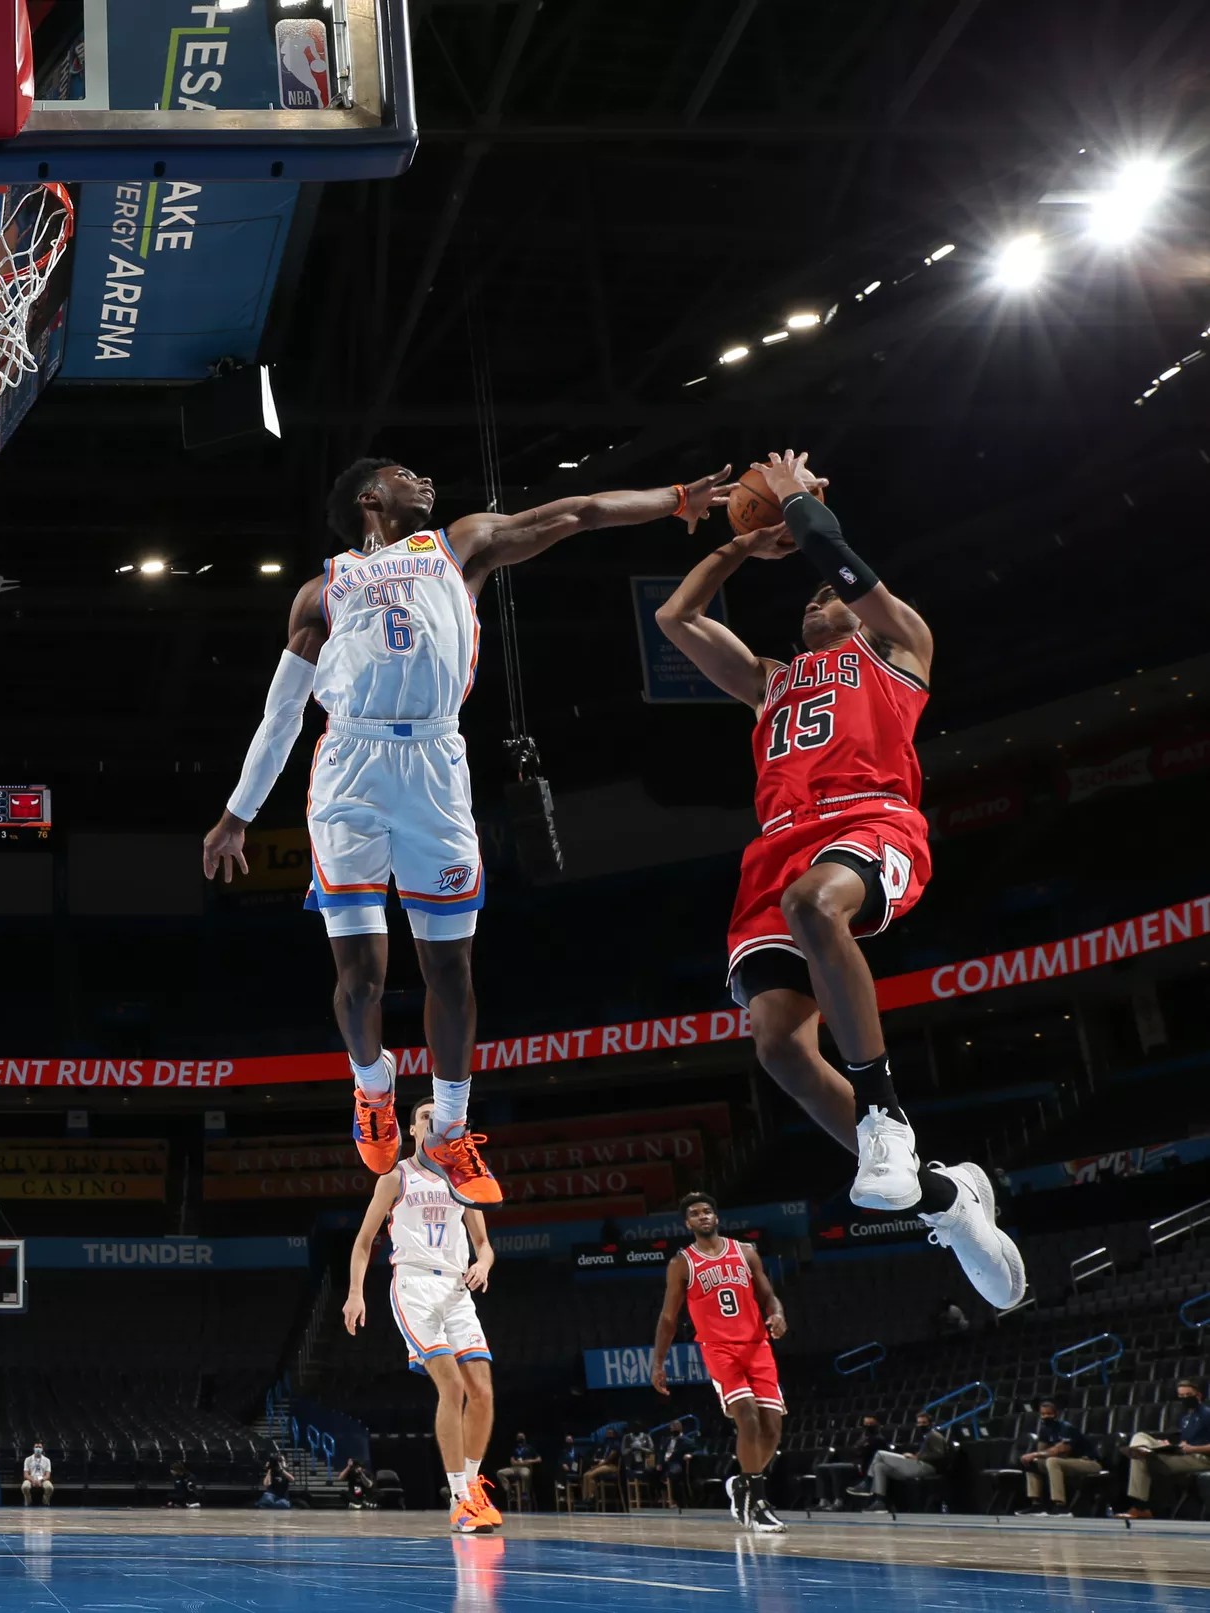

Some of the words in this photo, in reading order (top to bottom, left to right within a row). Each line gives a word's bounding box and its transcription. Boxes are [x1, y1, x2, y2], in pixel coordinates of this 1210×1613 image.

[287, 90, 312, 106] NBA
[110, 182, 142, 251] ERGY
[94, 254, 145, 360] ARENA
[328, 557, 447, 601] OKLAHOMA
[365, 578, 415, 607] CITY
[382, 605, 415, 654] 6
[766, 689, 836, 762] 15
[932, 896, 1210, 999] COMMITMENT
[601, 1014, 697, 1053] RUNS
[56, 1059, 144, 1086] RUNS
[153, 1060, 234, 1086] DEEP
[21, 1179, 126, 1196] CASINO
[260, 1175, 368, 1194] CASINO
[422, 1206, 447, 1220] CITY
[781, 1202, 807, 1215] 102
[287, 1237, 307, 1248] 101
[423, 1221, 447, 1248] 17
[82, 1243, 213, 1265] THUNDER
[577, 1252, 614, 1266] devon
[626, 1250, 665, 1263] devon
[698, 1264, 750, 1294] BULLS
[718, 1288, 739, 1318] 9
